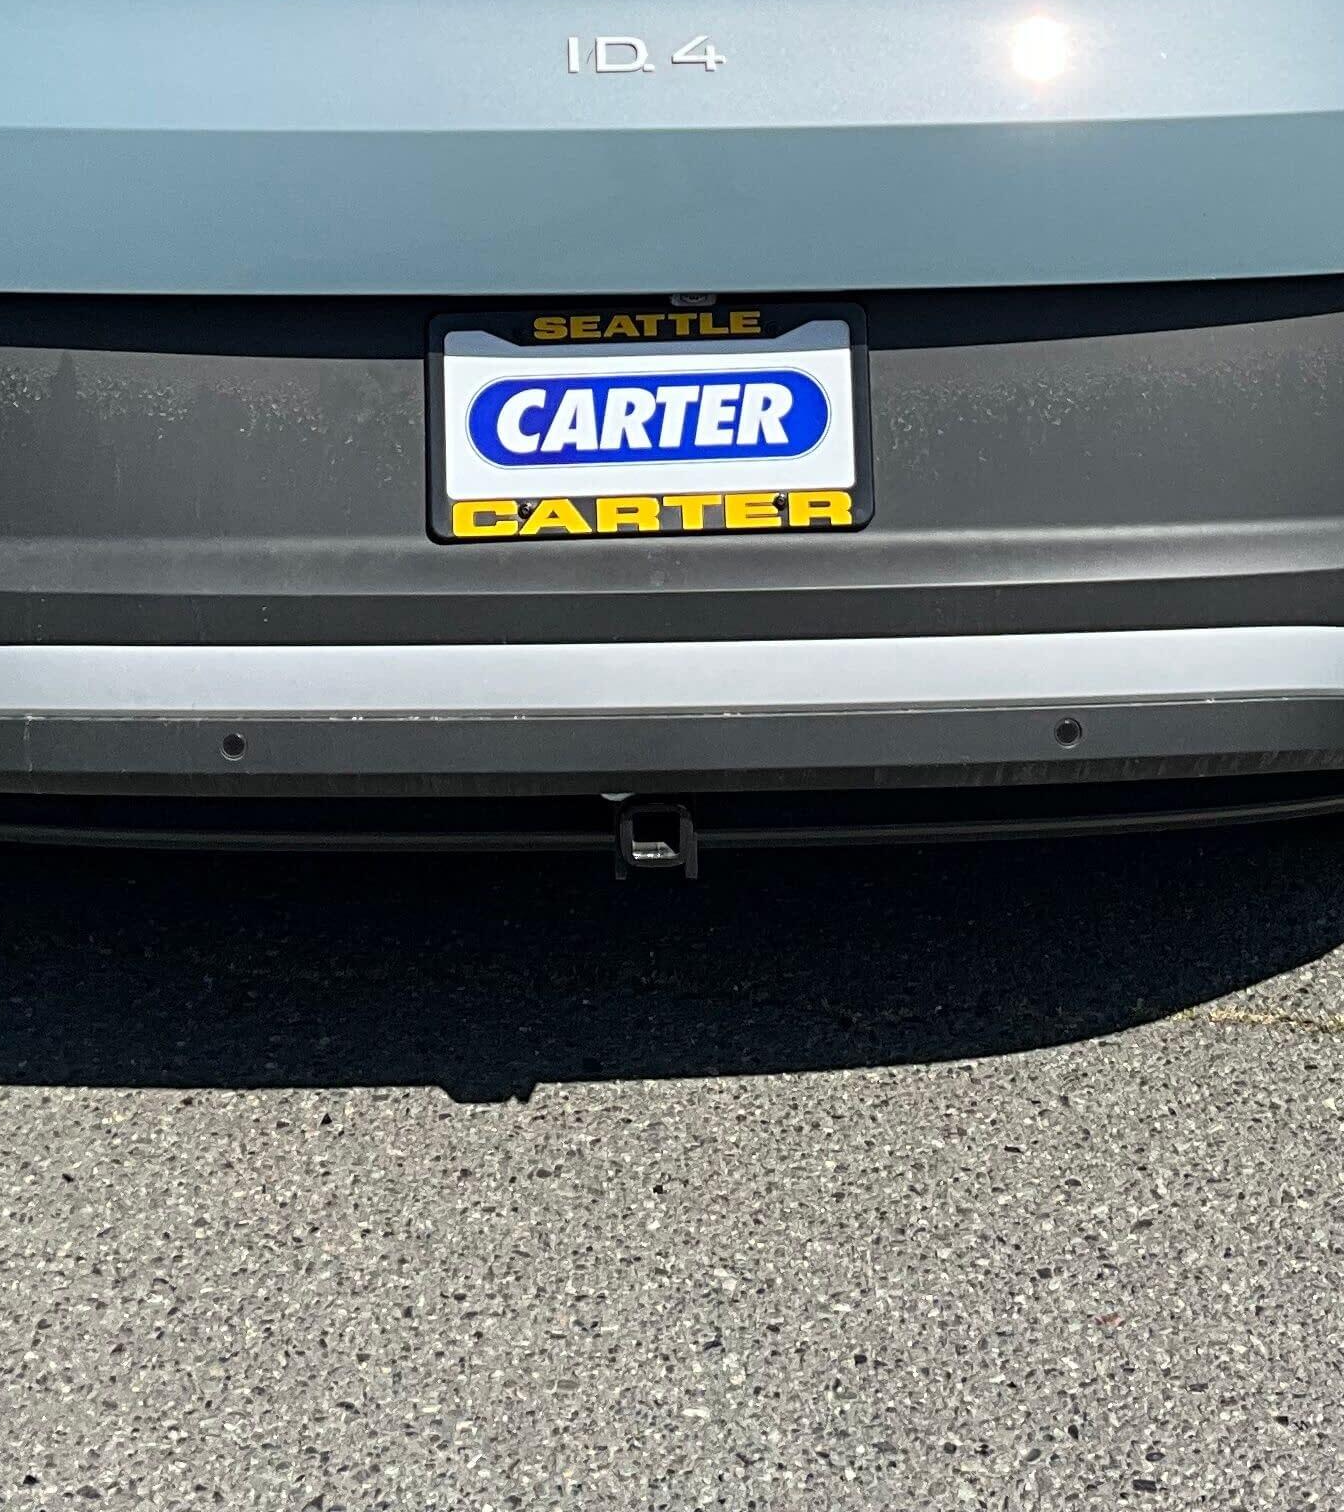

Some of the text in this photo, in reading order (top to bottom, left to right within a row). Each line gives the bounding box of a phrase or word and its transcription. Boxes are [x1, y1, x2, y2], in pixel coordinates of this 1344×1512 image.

[533, 310, 762, 340] SEATTLE
[496, 382, 794, 455] CARTER
[452, 490, 853, 537] CARTER
